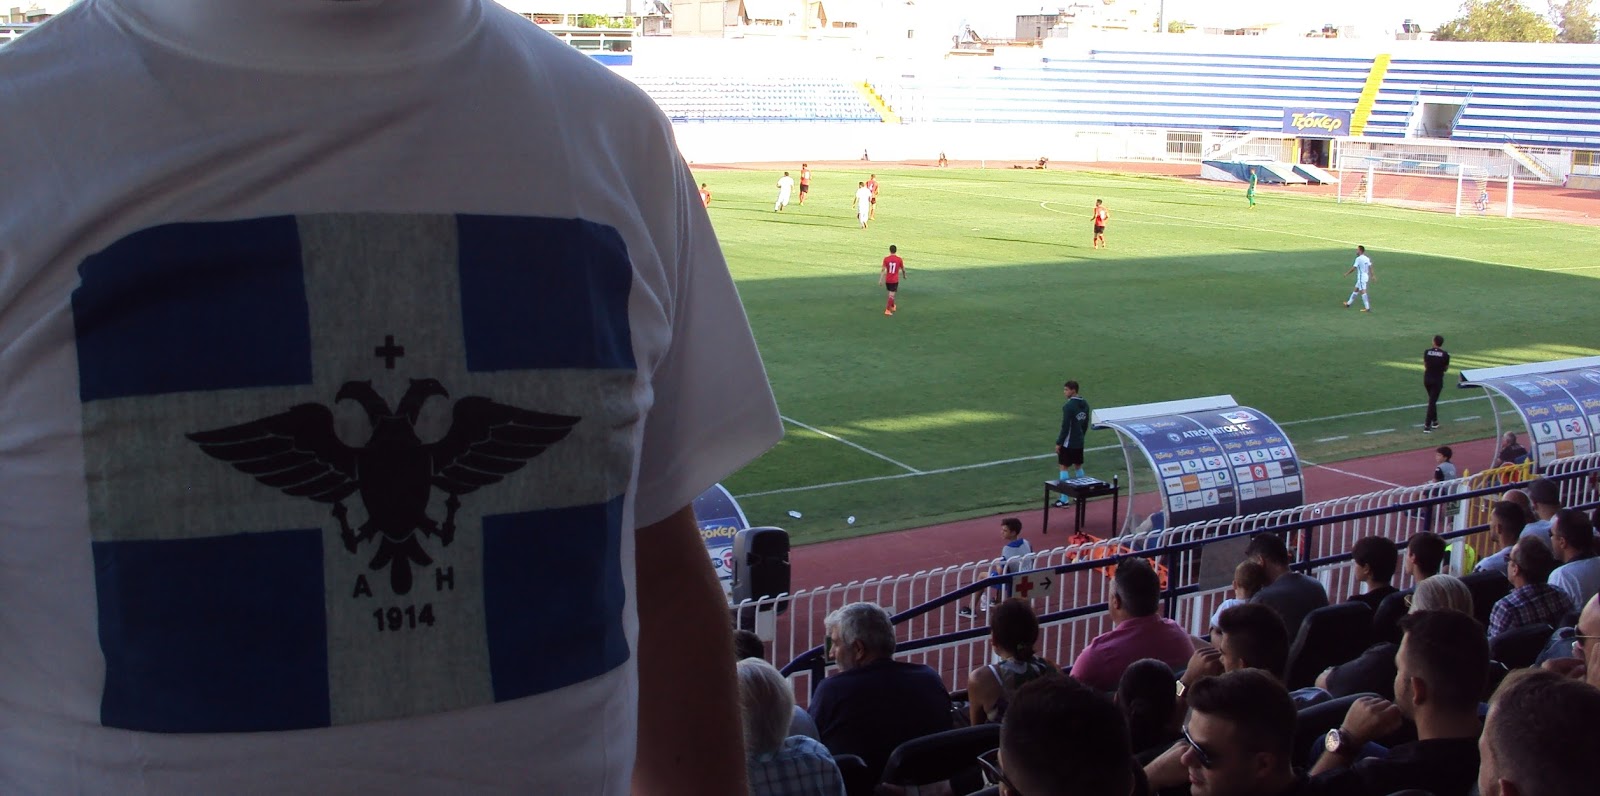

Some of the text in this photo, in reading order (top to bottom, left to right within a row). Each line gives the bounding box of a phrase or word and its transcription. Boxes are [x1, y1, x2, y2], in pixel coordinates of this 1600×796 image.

[353, 566, 454, 598] A H
[373, 603, 435, 632] 1914
